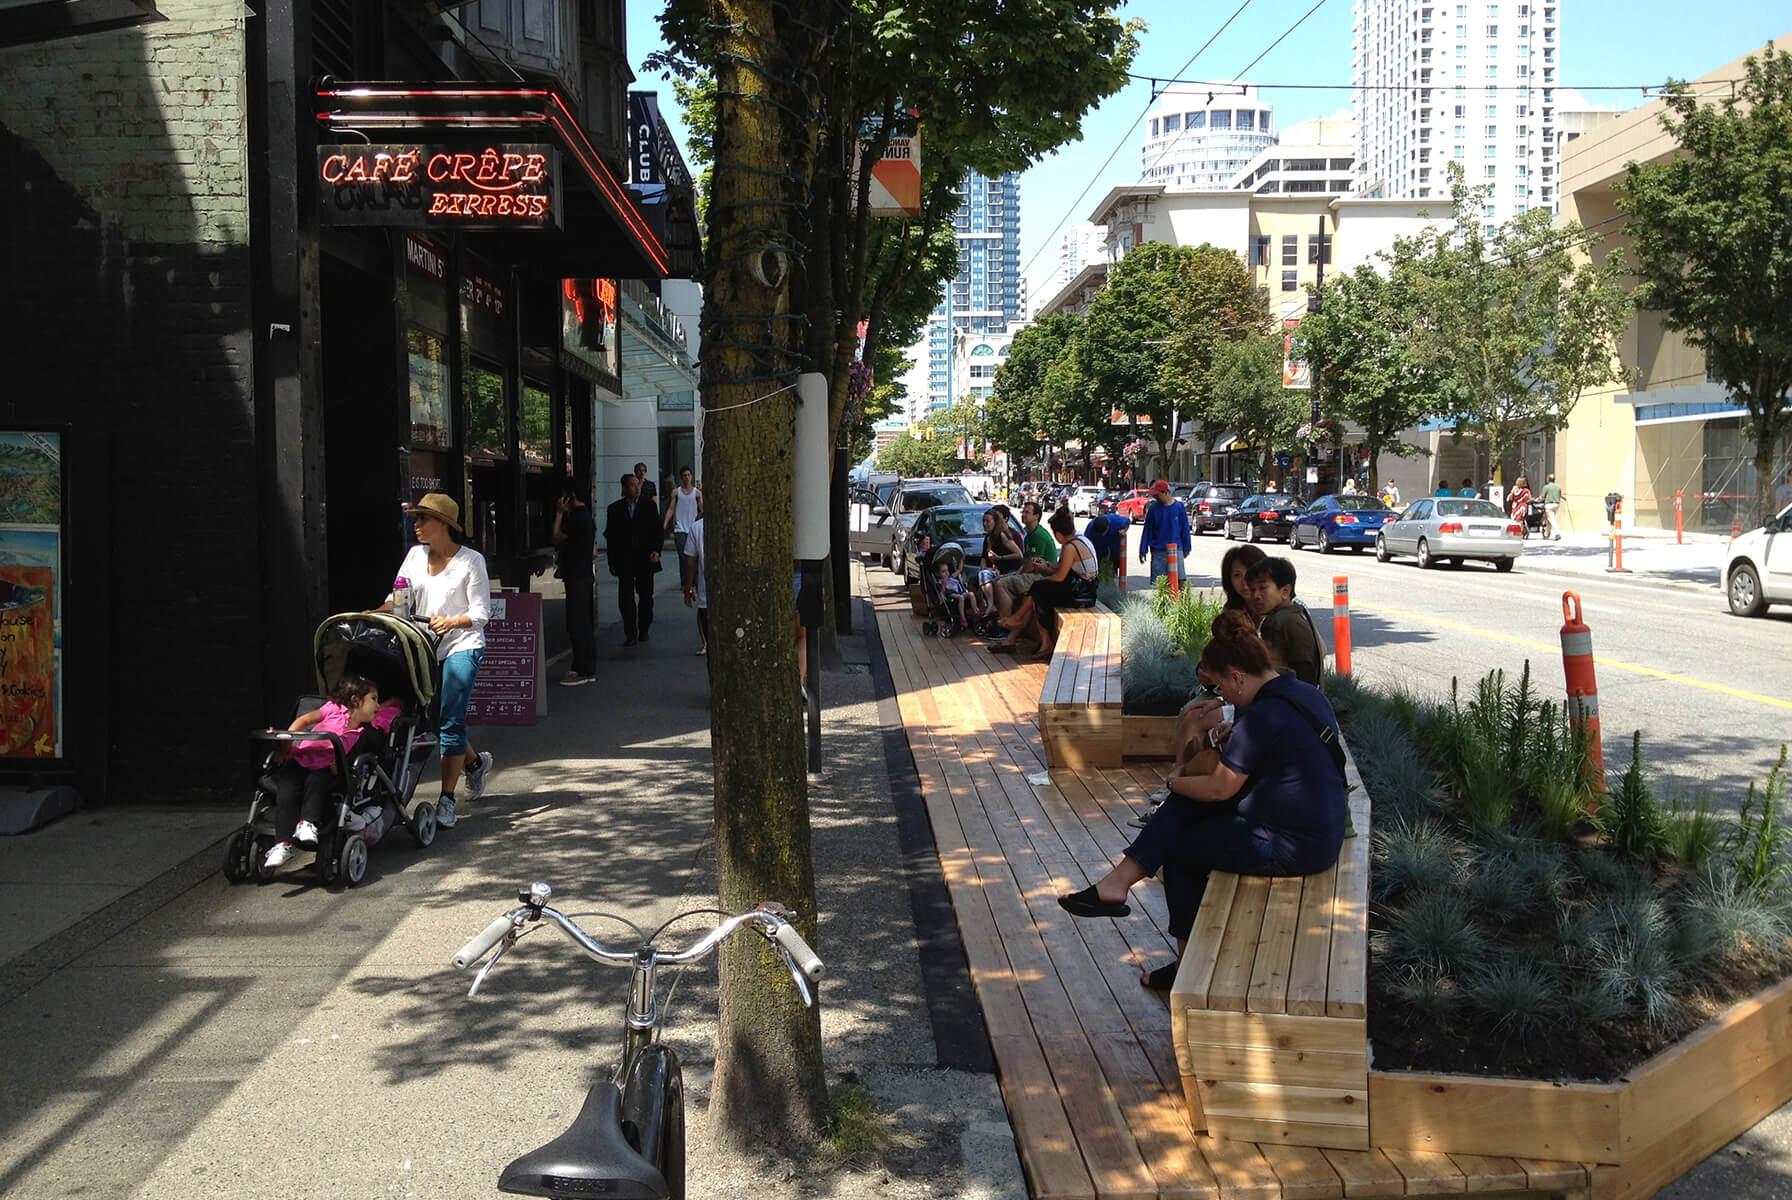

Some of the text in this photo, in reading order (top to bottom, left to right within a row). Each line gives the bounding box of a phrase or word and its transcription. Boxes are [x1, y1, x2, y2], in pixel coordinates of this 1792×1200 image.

[321, 148, 546, 191] CAFÉ CRÊPE
[638, 124, 651, 183] CLUB
[428, 192, 548, 217] EXPRESS
[406, 237, 437, 276] MARTINI
